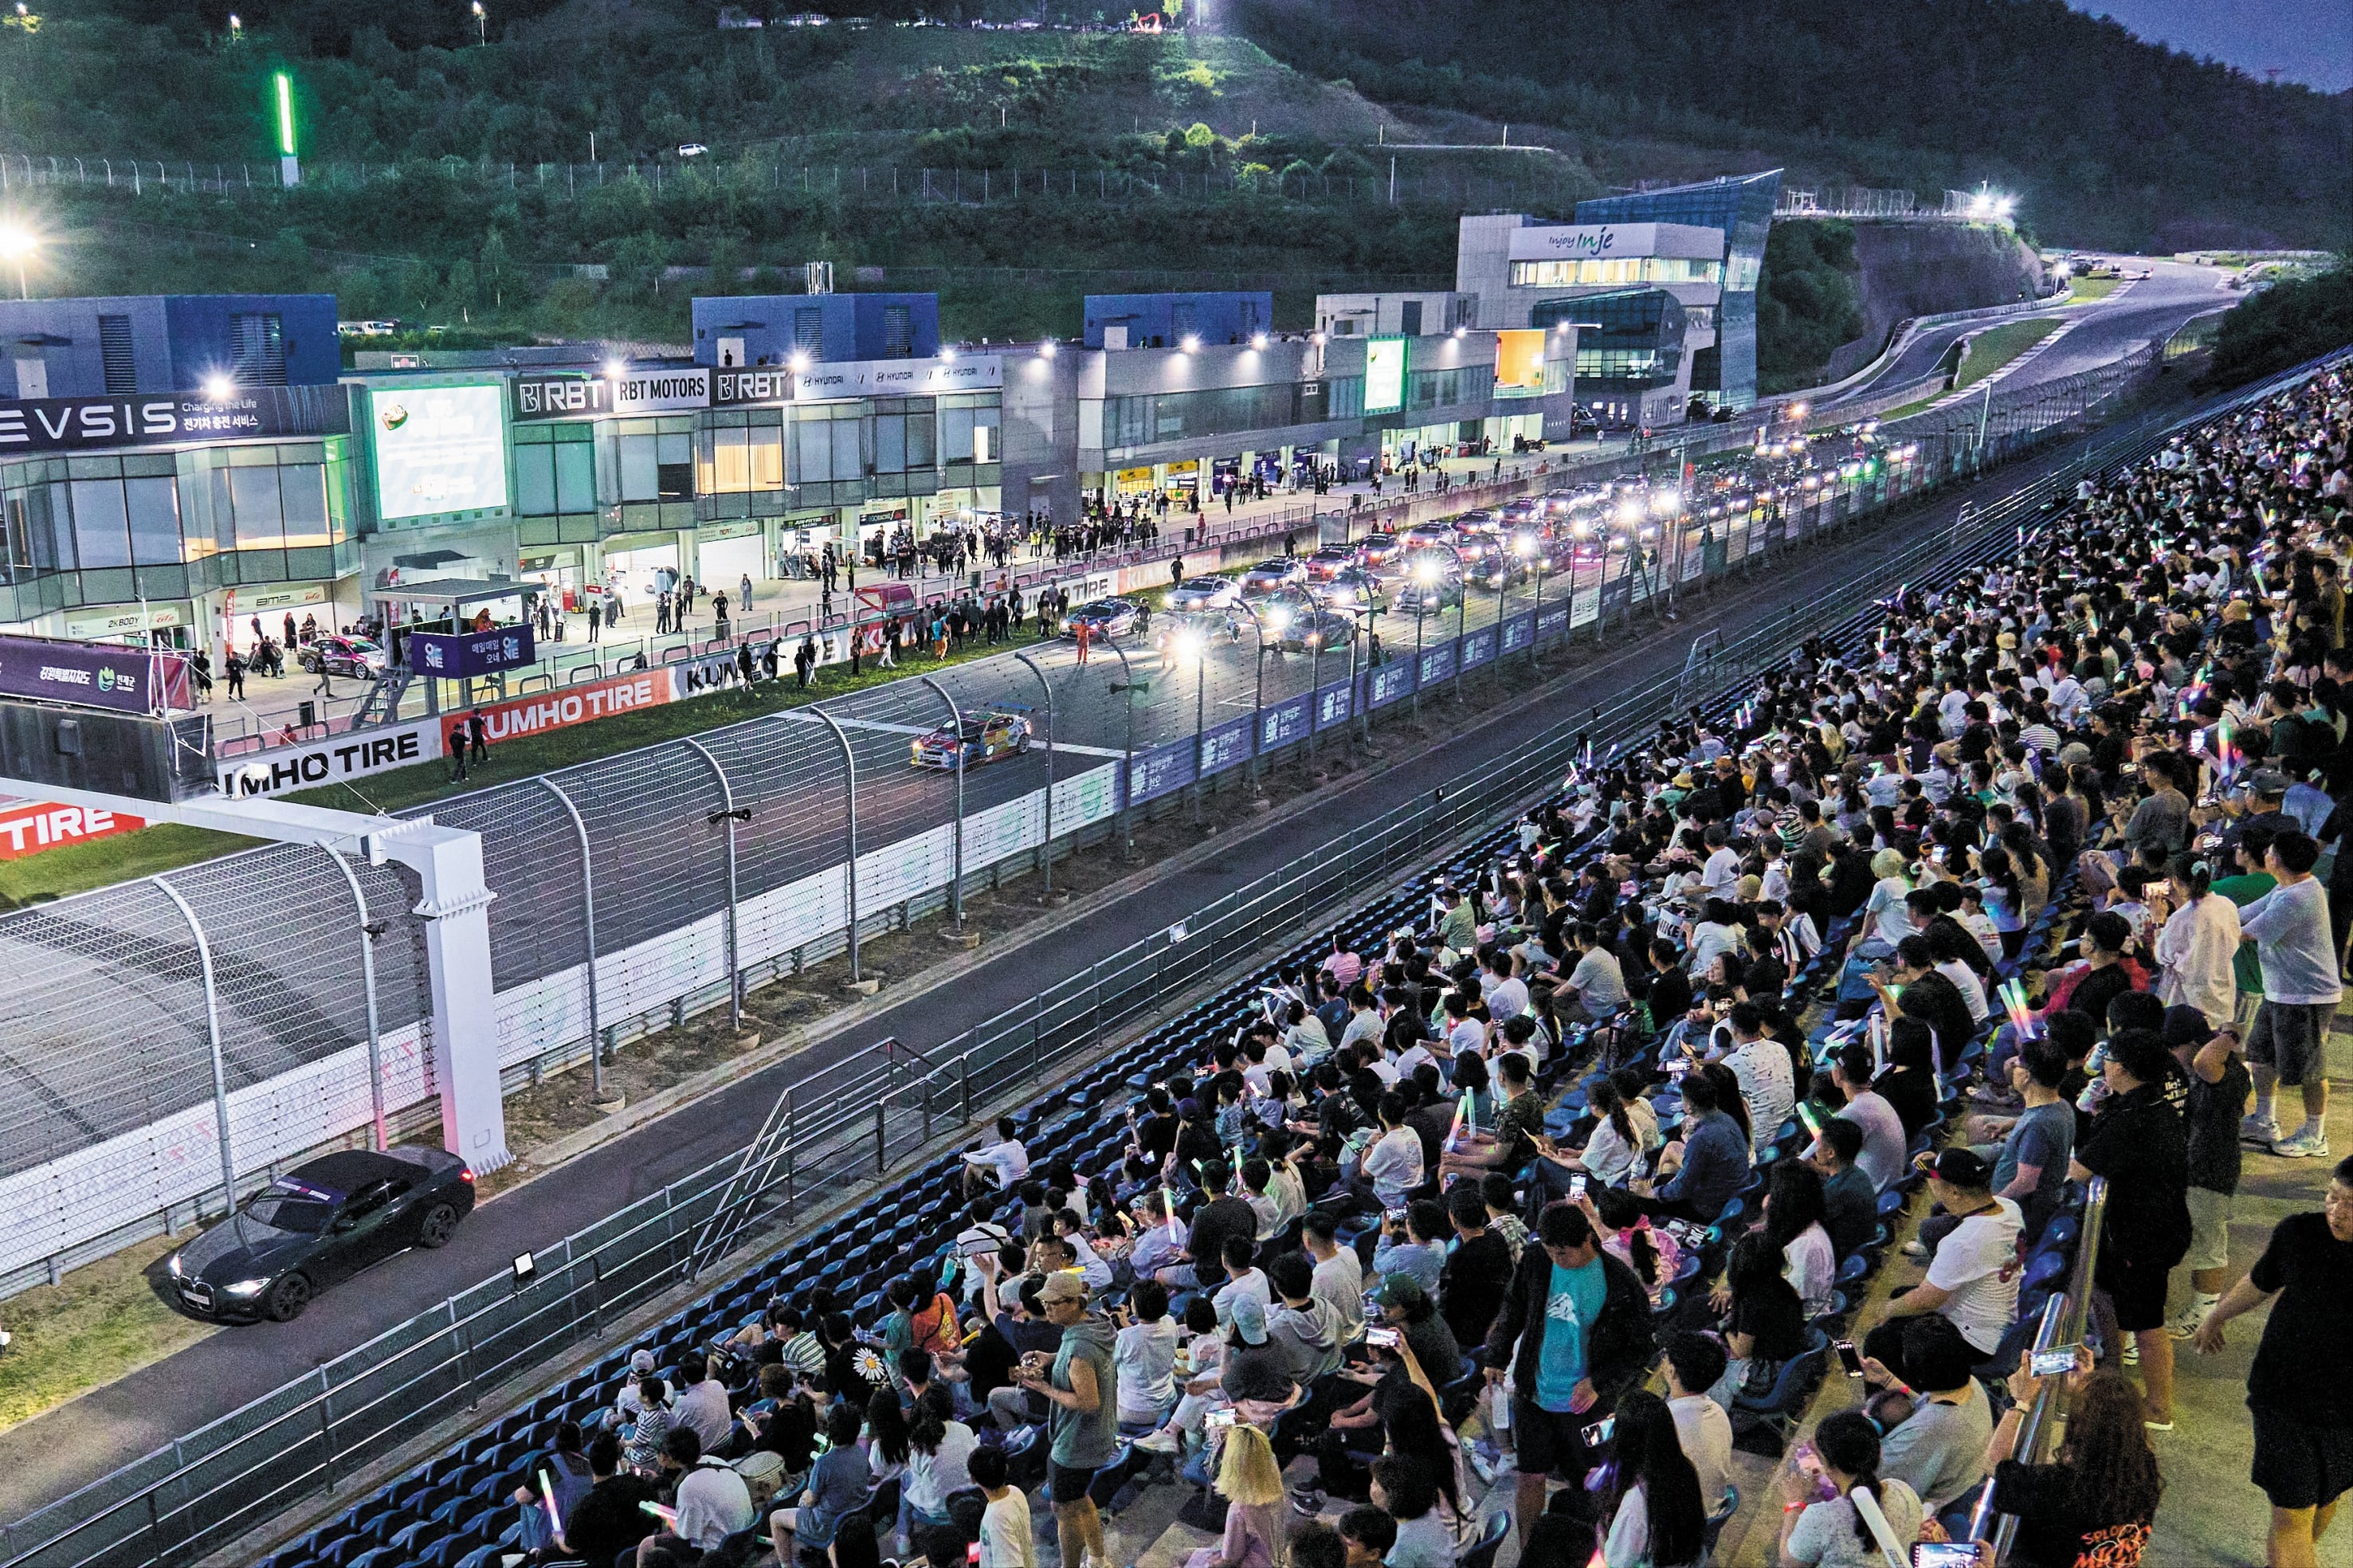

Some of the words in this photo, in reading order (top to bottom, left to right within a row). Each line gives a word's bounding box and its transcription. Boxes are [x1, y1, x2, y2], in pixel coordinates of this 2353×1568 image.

[1577, 226, 1614, 255] Inje
[814, 376, 844, 385] HYUNDAI
[886, 372, 913, 381] HYUNDAI
[952, 368, 978, 377] HYUNDAI
[620, 380, 646, 401] RBT
[649, 377, 705, 398] MOTORS
[738, 372, 786, 398] RBT
[545, 380, 604, 411] RBT
[182, 402, 224, 414] Charging
[225, 402, 239, 410] the
[241, 399, 257, 410] Life
[0, 402, 177, 442] EVSIS
[183, 417, 211, 431] 전기차
[213, 416, 230, 429] 충전
[232, 415, 258, 427] 서비스
[1073, 578, 1108, 601] TIRE
[108, 617, 139, 628] 2KBODY
[472, 639, 499, 653] 매일매일
[486, 653, 500, 664] 오네
[117, 674, 135, 688] 인제군
[586, 680, 653, 715] TIRE
[334, 732, 419, 773] TIRE
[0, 807, 115, 851] TIRE
